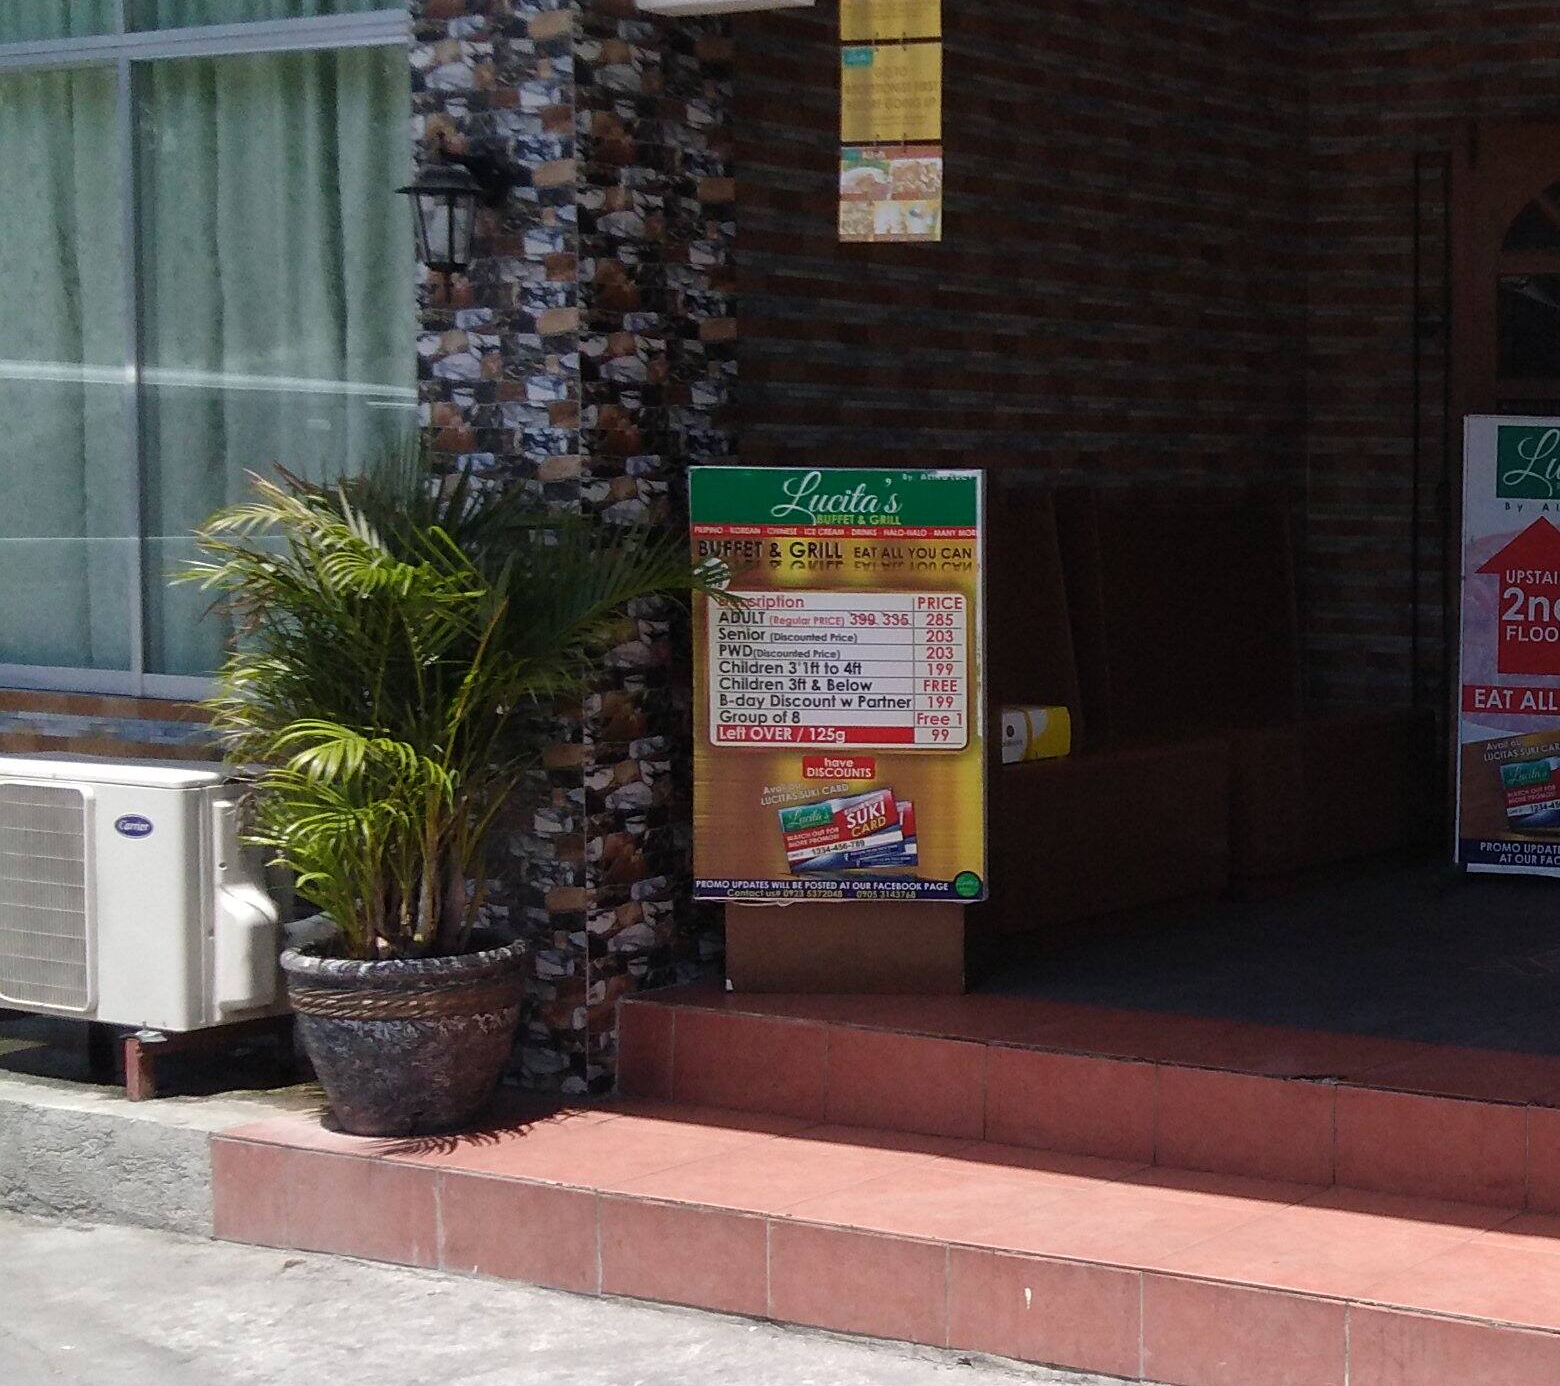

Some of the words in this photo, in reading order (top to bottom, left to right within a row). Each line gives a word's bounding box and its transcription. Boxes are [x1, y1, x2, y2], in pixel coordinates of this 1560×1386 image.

[771, 471, 902, 525] Lucita's
[700, 539, 762, 557] BUFFET
[769, 542, 781, 557] &
[789, 542, 843, 558] GRILL
[854, 547, 877, 558] EAT
[881, 547, 903, 558] ALL
[908, 547, 936, 559] YOU
[941, 548, 972, 559] CAN
[918, 597, 962, 609] PRICE
[719, 611, 765, 624] ADULT
[926, 613, 954, 626] 285
[719, 627, 766, 641] Senior
[926, 630, 954, 643] 203
[719, 645, 753, 657] PWD
[926, 646, 954, 659] 203
[719, 661, 784, 674] Children
[824, 662, 839, 674] to
[844, 662, 862, 675] 4ft
[928, 663, 954, 676] 199
[720, 677, 784, 691] Children
[789, 678, 807, 691] 3ft
[811, 679, 821, 691] &
[828, 678, 873, 691] Below
[923, 679, 958, 692] FREE
[720, 694, 765, 709] B-day
[770, 694, 836, 708] Discount
[841, 698, 853, 708] w
[858, 696, 912, 709] Partner
[928, 696, 954, 709] 199
[1475, 689, 1514, 709] EAT
[1520, 691, 1558, 711] ALL
[720, 710, 768, 726] Group
[772, 710, 788, 724] of
[792, 711, 801, 724] 8
[917, 713, 950, 726] Free
[720, 726, 746, 740] Left
[750, 727, 792, 741] OVER
[809, 728, 846, 744] 125g
[932, 728, 950, 742] 99
[824, 757, 854, 767] have
[807, 768, 872, 778] DISCOUNTS
[846, 797, 885, 829] SUKI
[851, 817, 887, 838] CARD
[1480, 842, 1521, 853] PROMO
[1500, 853, 1514, 863] AT
[1516, 853, 1537, 864] OUR
